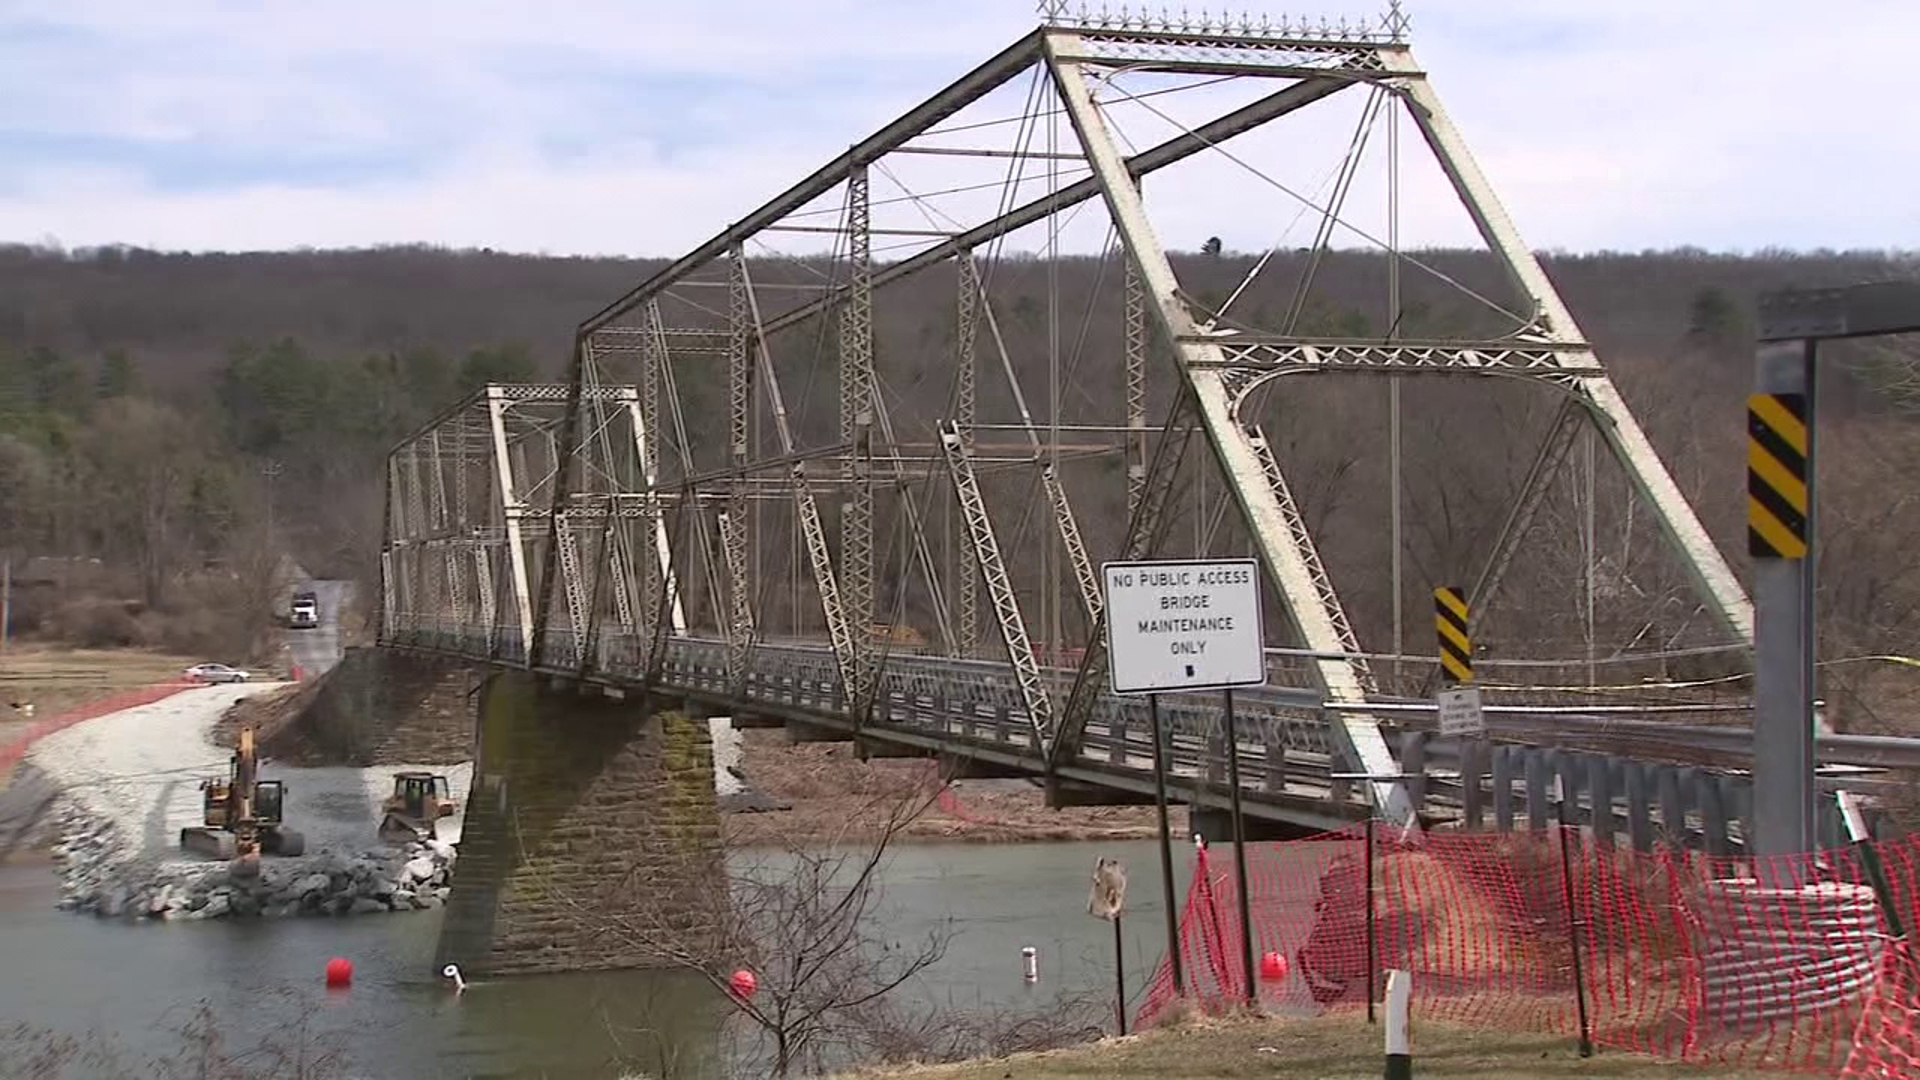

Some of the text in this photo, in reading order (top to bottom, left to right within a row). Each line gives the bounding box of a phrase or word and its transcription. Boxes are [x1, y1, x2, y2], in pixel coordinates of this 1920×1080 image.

[1113, 570, 1249, 587] NO PUBLIC ACCESS
[1160, 595, 1210, 609] BRIDGE
[1138, 617, 1235, 633] MAINTENANCE
[1170, 641, 1207, 655] ONLY
